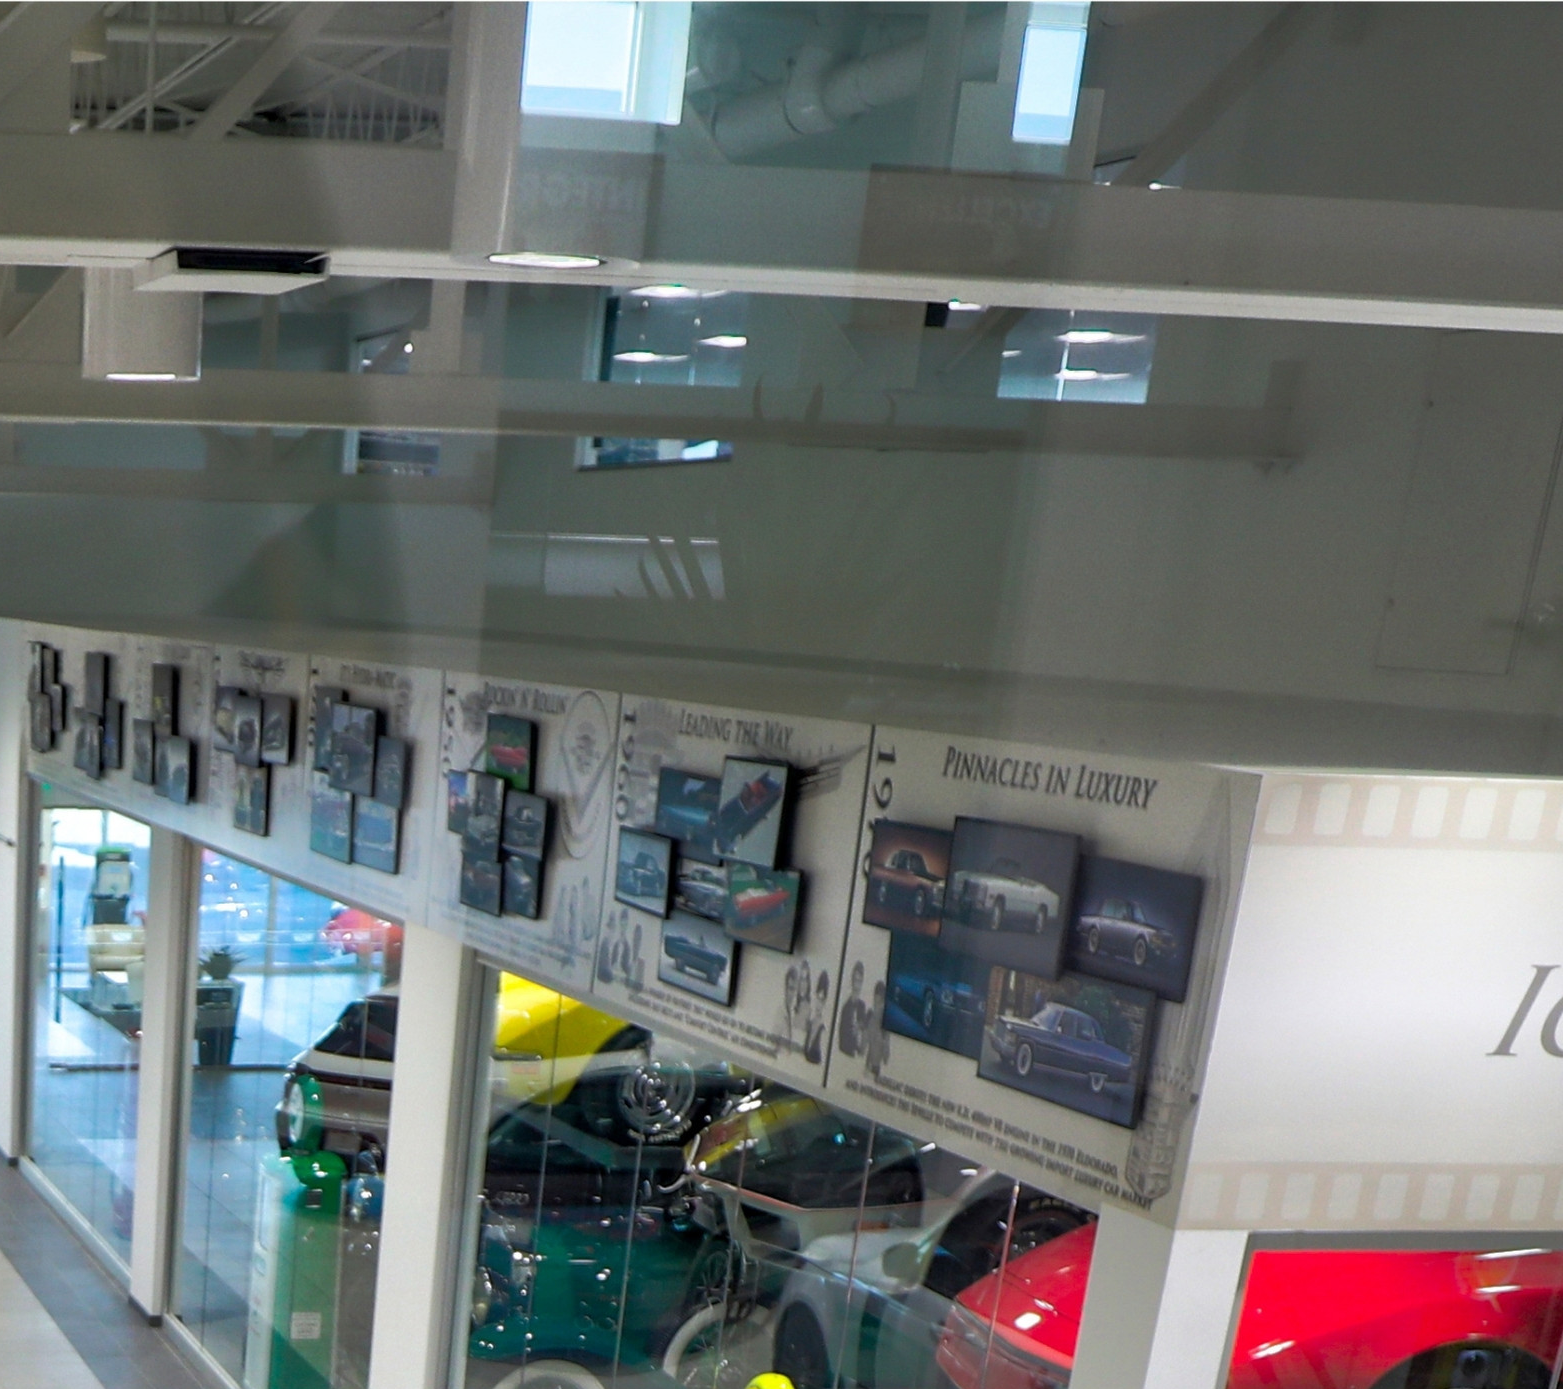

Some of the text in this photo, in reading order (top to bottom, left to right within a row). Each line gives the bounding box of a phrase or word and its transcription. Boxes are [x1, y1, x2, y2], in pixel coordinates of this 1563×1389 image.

[678, 708, 794, 751] LEADING THE WAY
[942, 745, 1158, 809] PINNACLES IN LUXURY
